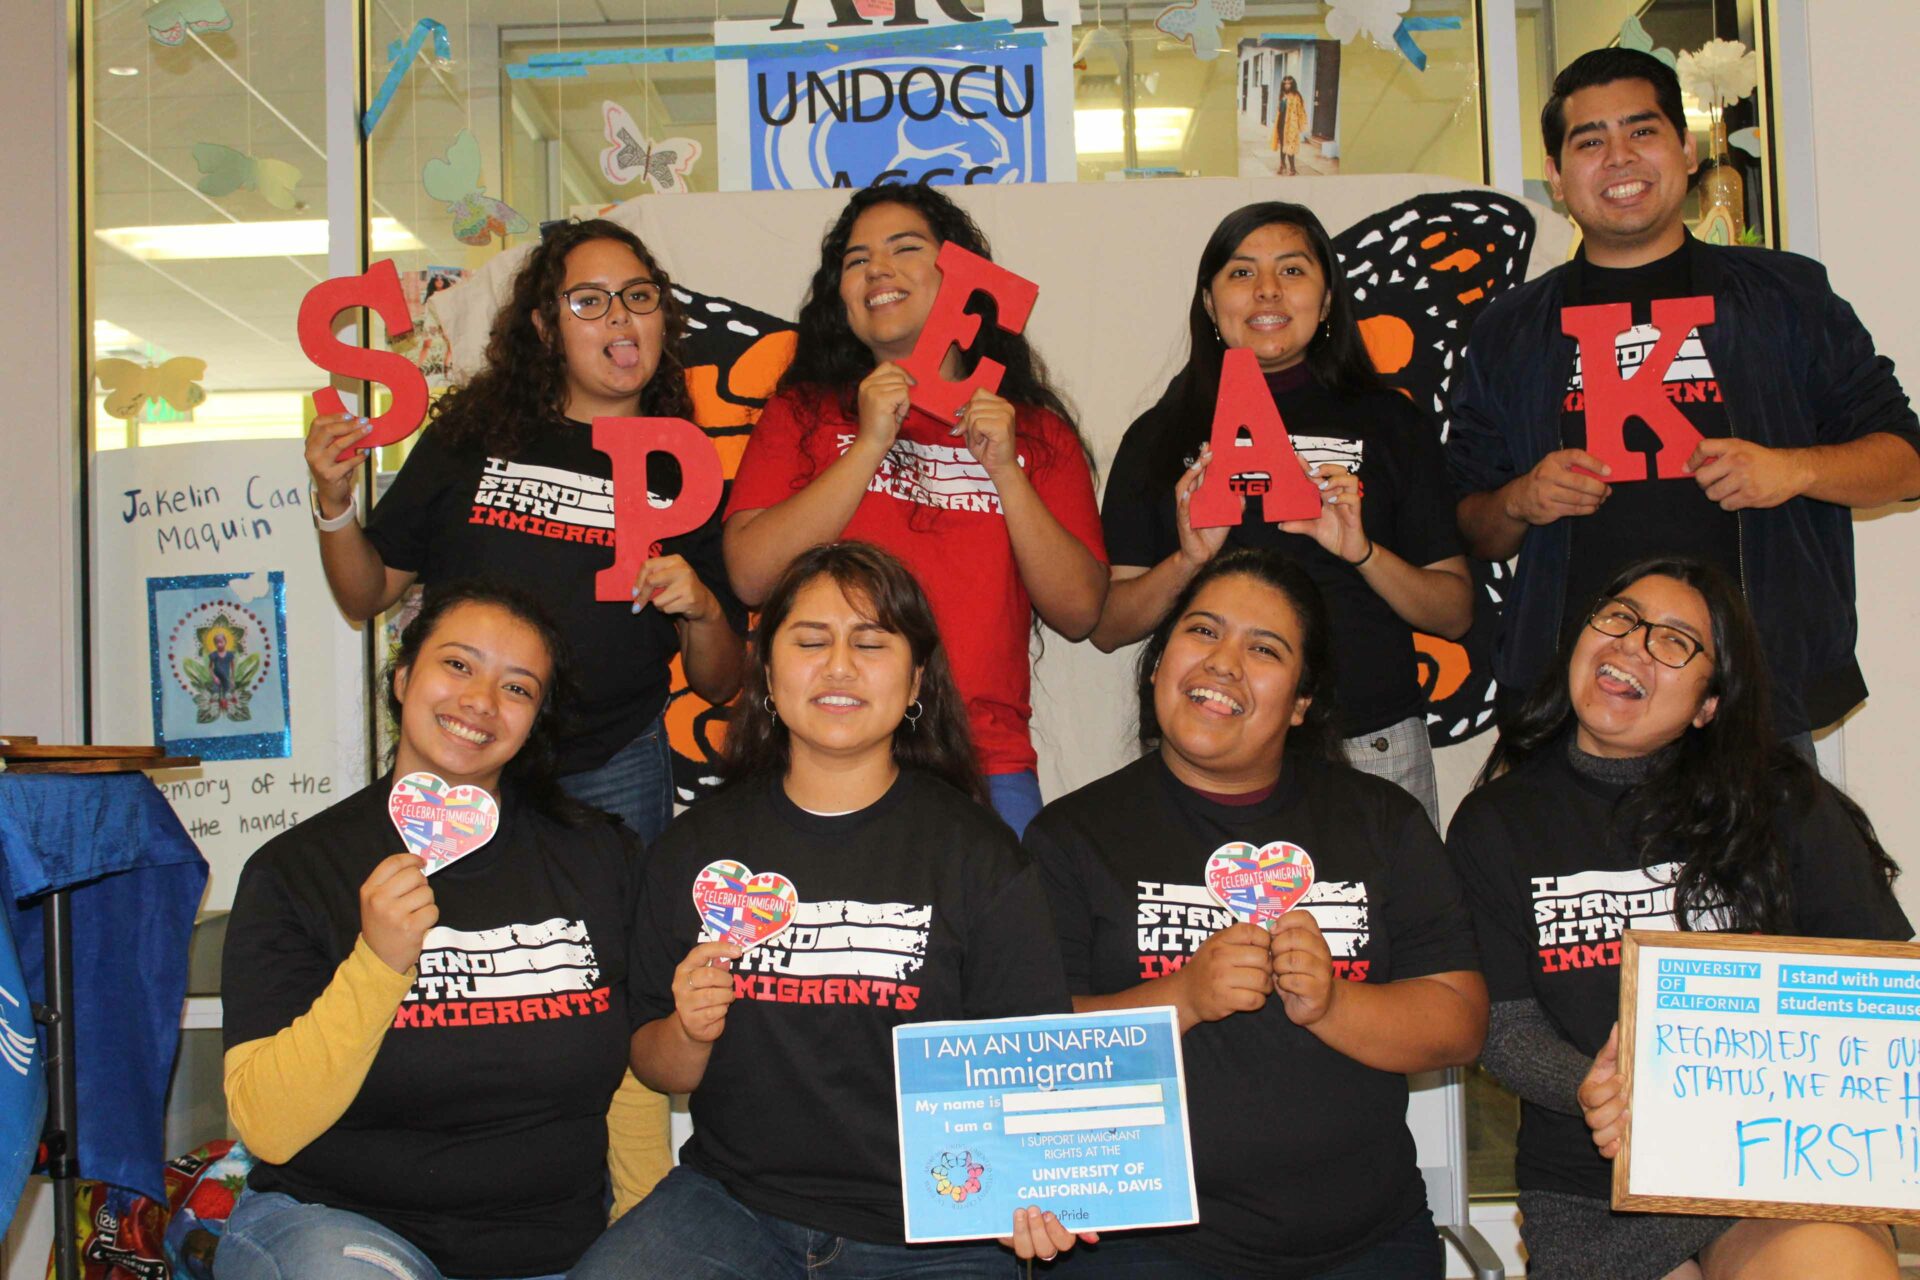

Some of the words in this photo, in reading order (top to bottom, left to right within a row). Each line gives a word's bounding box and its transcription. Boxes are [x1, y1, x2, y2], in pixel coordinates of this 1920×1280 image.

[756, 64, 1035, 127] UNDOCU
[484, 457, 508, 474] I
[122, 484, 220, 524] Jakelin
[474, 490, 566, 520] WITH
[479, 475, 581, 508] STAND
[157, 517, 272, 554] Maquin
[160, 778, 231, 804] emory
[251, 773, 275, 794] of
[289, 773, 332, 794] the
[189, 818, 221, 839] the
[240, 809, 299, 833] hands
[1138, 881, 1162, 900] I
[1531, 877, 1559, 899] I
[1138, 902, 1233, 930] STAN
[1534, 893, 1653, 925] STAND
[1138, 926, 1214, 953] WIT
[419, 950, 495, 976] AND
[1661, 960, 1759, 977] UNIVERSITY
[733, 973, 921, 1012] MIGRANTS
[1660, 978, 1682, 991] OF
[1782, 969, 1788, 983] I
[1791, 969, 1838, 987] stand
[1841, 973, 1879, 990] with
[391, 987, 611, 1029] MMIGRANTS
[1659, 995, 1757, 1013] CALIFORNIA
[1780, 996, 1854, 1013] students
[923, 1038, 930, 1059] I
[937, 1036, 977, 1058] AM
[983, 1032, 1021, 1056] AN
[1027, 1025, 1148, 1054] UNAFRAID
[1656, 1023, 1821, 1063] REGARDLESS
[1839, 1035, 1871, 1067] OF
[1888, 1036, 1920, 1069] OU
[964, 1055, 1114, 1091] Immigrant
[1784, 1070, 1830, 1099] WE
[1839, 1074, 1894, 1104] ARE
[915, 1100, 938, 1115] My
[943, 1098, 985, 1112] name
[989, 1095, 1001, 1109] is
[944, 1121, 950, 1134] I
[954, 1121, 978, 1133] am
[983, 1121, 993, 1131] a
[1028, 1133, 1075, 1147] SUPPORT
[1078, 1129, 1142, 1144] IMMIGRANT
[1044, 1147, 1083, 1160] RIGHTS
[1085, 1146, 1098, 1158] AT
[1102, 1144, 1121, 1156] THE
[1032, 1163, 1120, 1182] UNIVERSITY
[1124, 1162, 1145, 1176] OF
[1017, 1182, 1114, 1200] CALIFORNIA,
[1118, 1177, 1164, 1193] DAVIS
